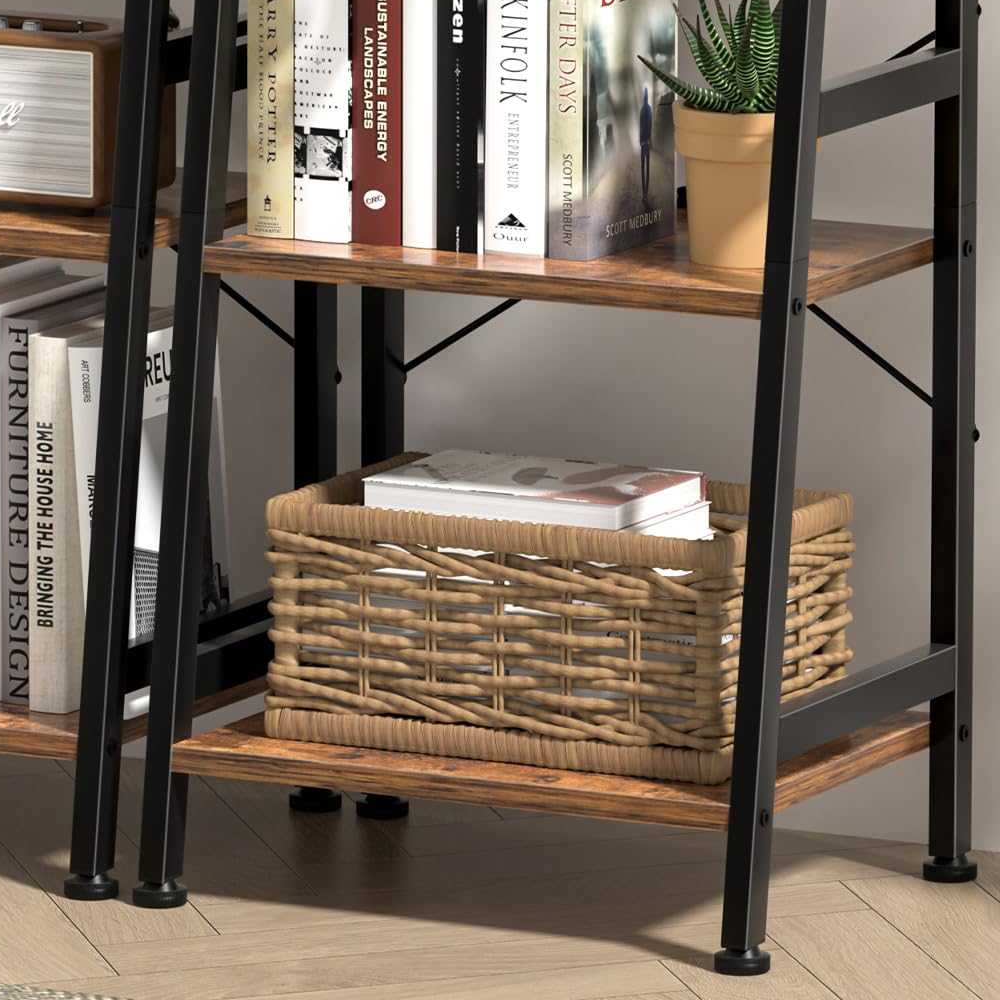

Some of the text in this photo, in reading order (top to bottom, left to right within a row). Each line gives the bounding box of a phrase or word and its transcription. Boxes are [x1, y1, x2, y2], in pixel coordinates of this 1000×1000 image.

[364, 27, 374, 129] LANDSCAPES
[558, 58, 577, 114] DAYS
[266, 72, 277, 164] POTTER
[377, 101, 388, 162] ENERGY
[507, 113, 520, 189] ENTREPRENEUR
[365, 194, 383, 205] CRC
[562, 153, 573, 247] SCOTT MEDBURY
[605, 208, 663, 238] SCOTT MEDBURY
[81, 359, 89, 373] ART
[8, 325, 30, 700] FURNITURE DESIGN
[36, 421, 54, 628] BRINGING THE HOUSE HOME
